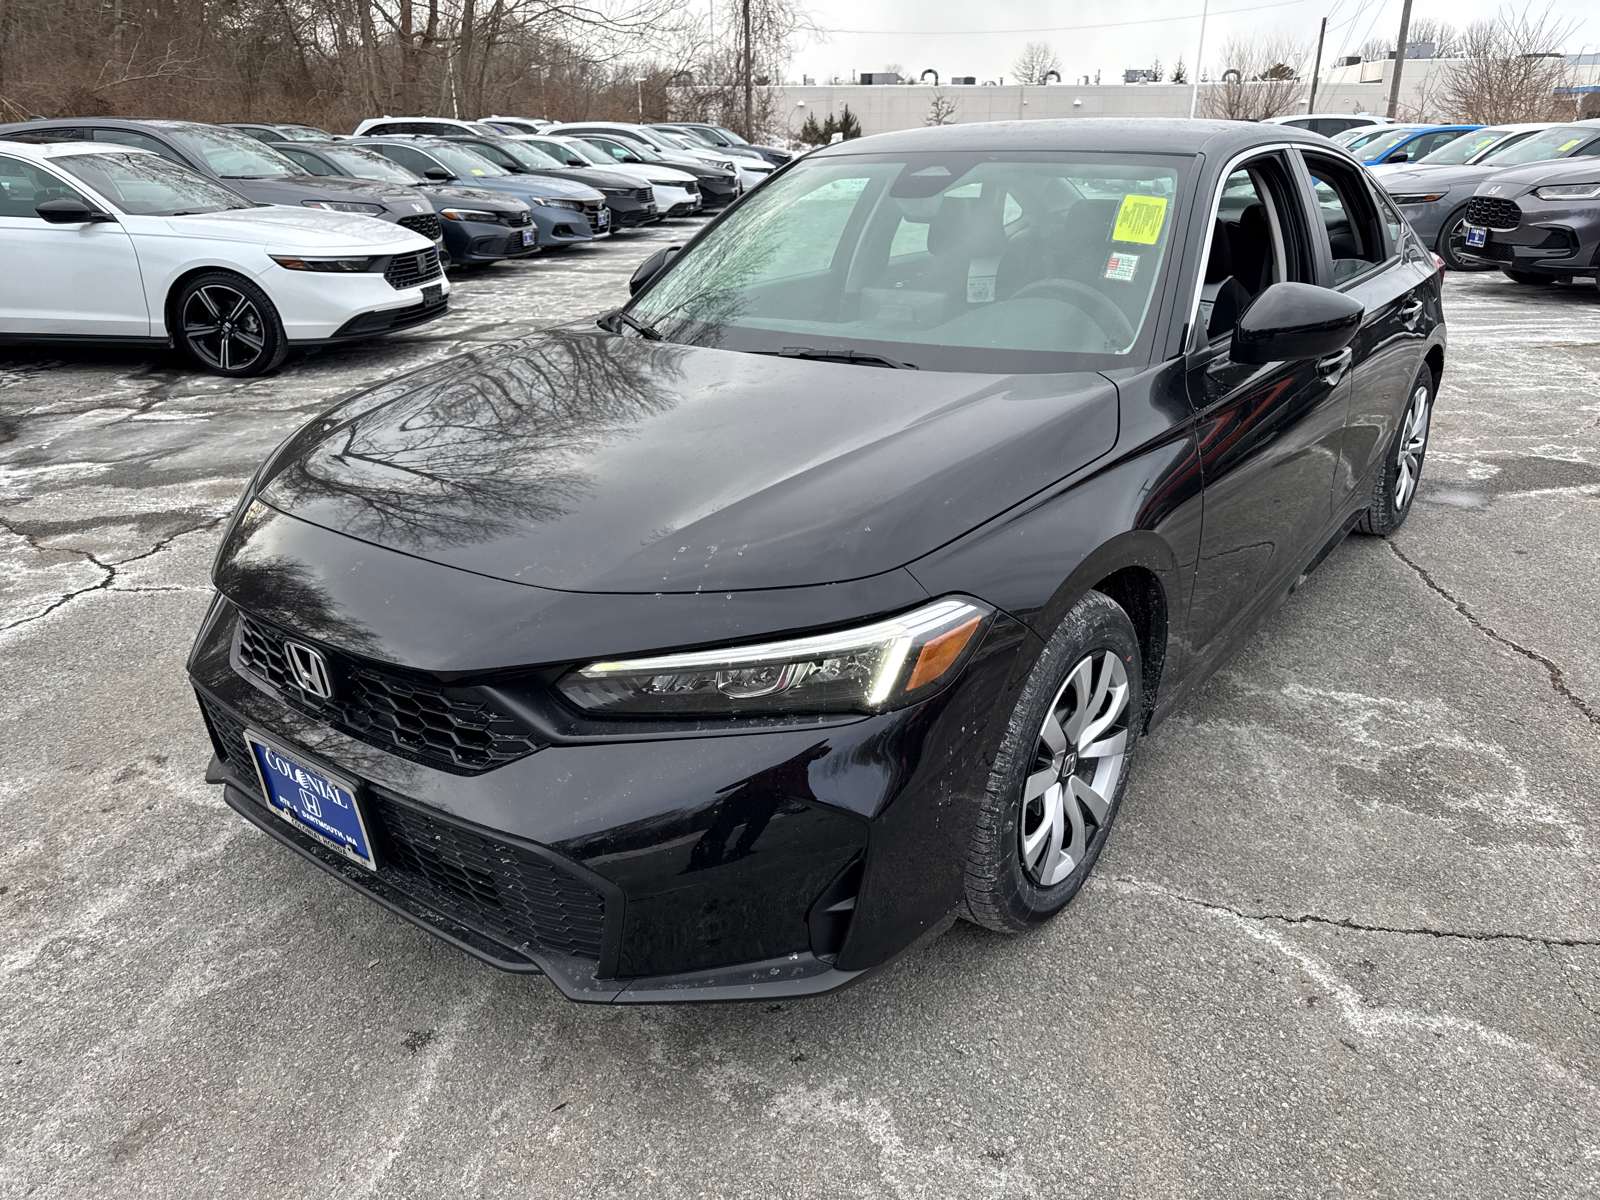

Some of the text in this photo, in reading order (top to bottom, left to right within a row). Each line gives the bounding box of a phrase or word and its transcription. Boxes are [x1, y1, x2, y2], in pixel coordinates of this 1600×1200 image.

[265, 749, 348, 810] COLONIAL
[323, 837, 348, 856] HONDA
[346, 834, 358, 847] MA
